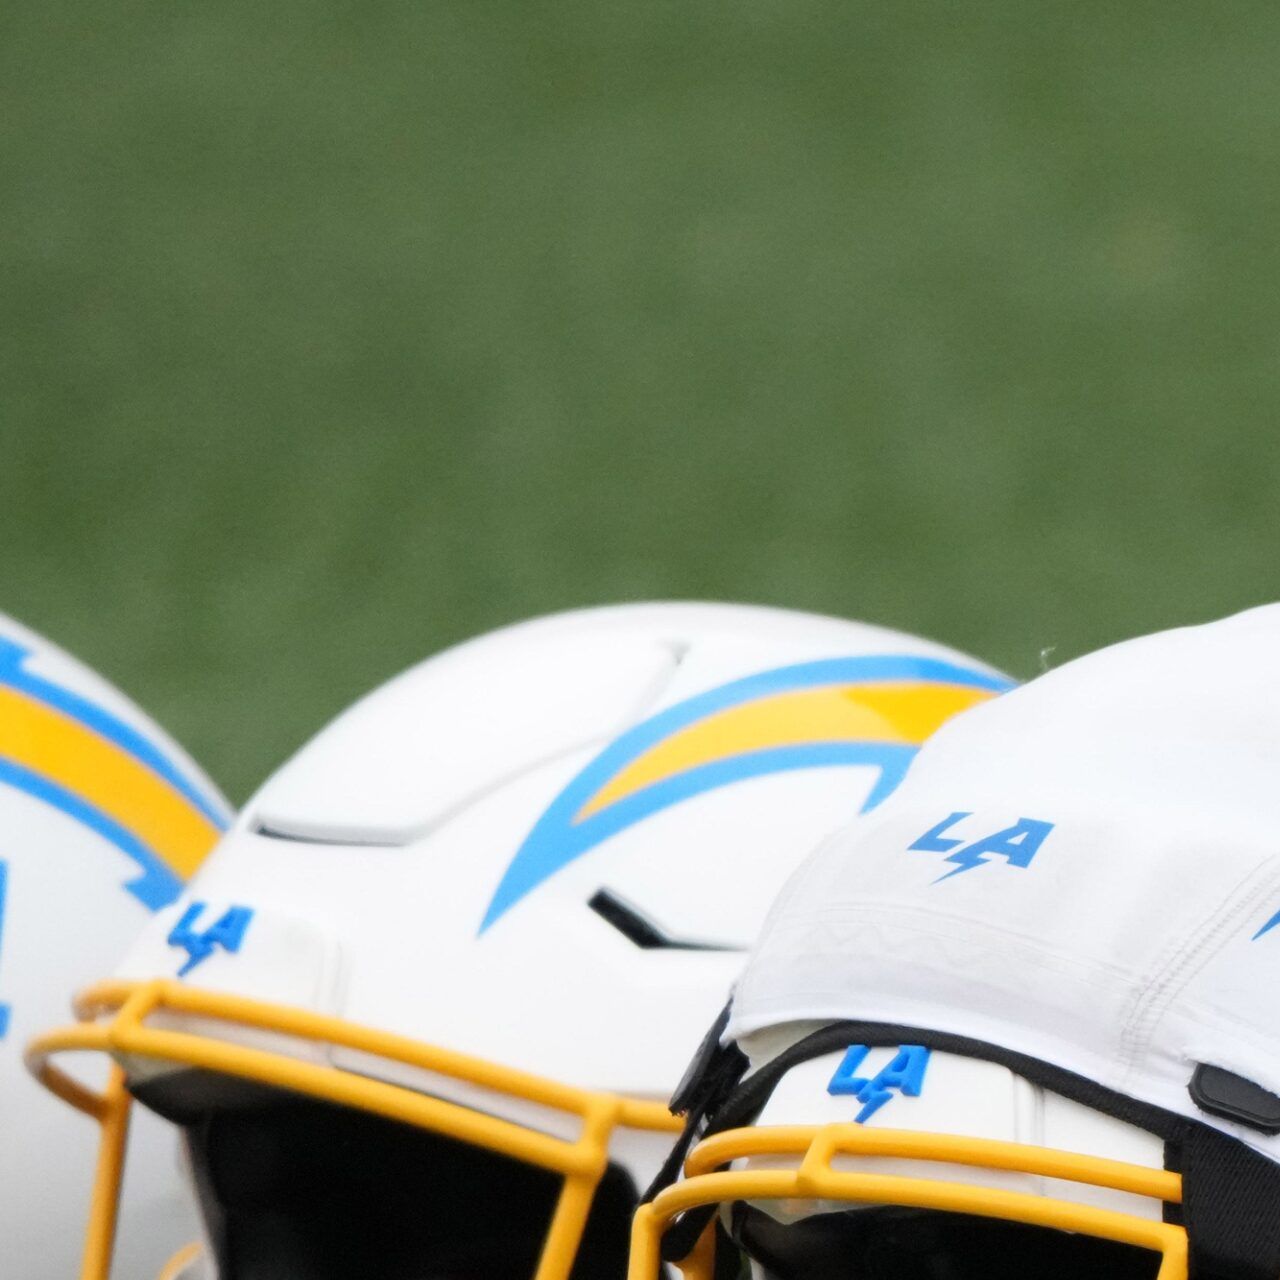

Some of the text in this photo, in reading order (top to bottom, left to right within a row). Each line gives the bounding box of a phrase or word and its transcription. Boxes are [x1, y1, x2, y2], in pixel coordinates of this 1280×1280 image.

[907, 812, 1055, 885] LA
[168, 901, 255, 978] LA
[827, 1044, 933, 1124] LA
